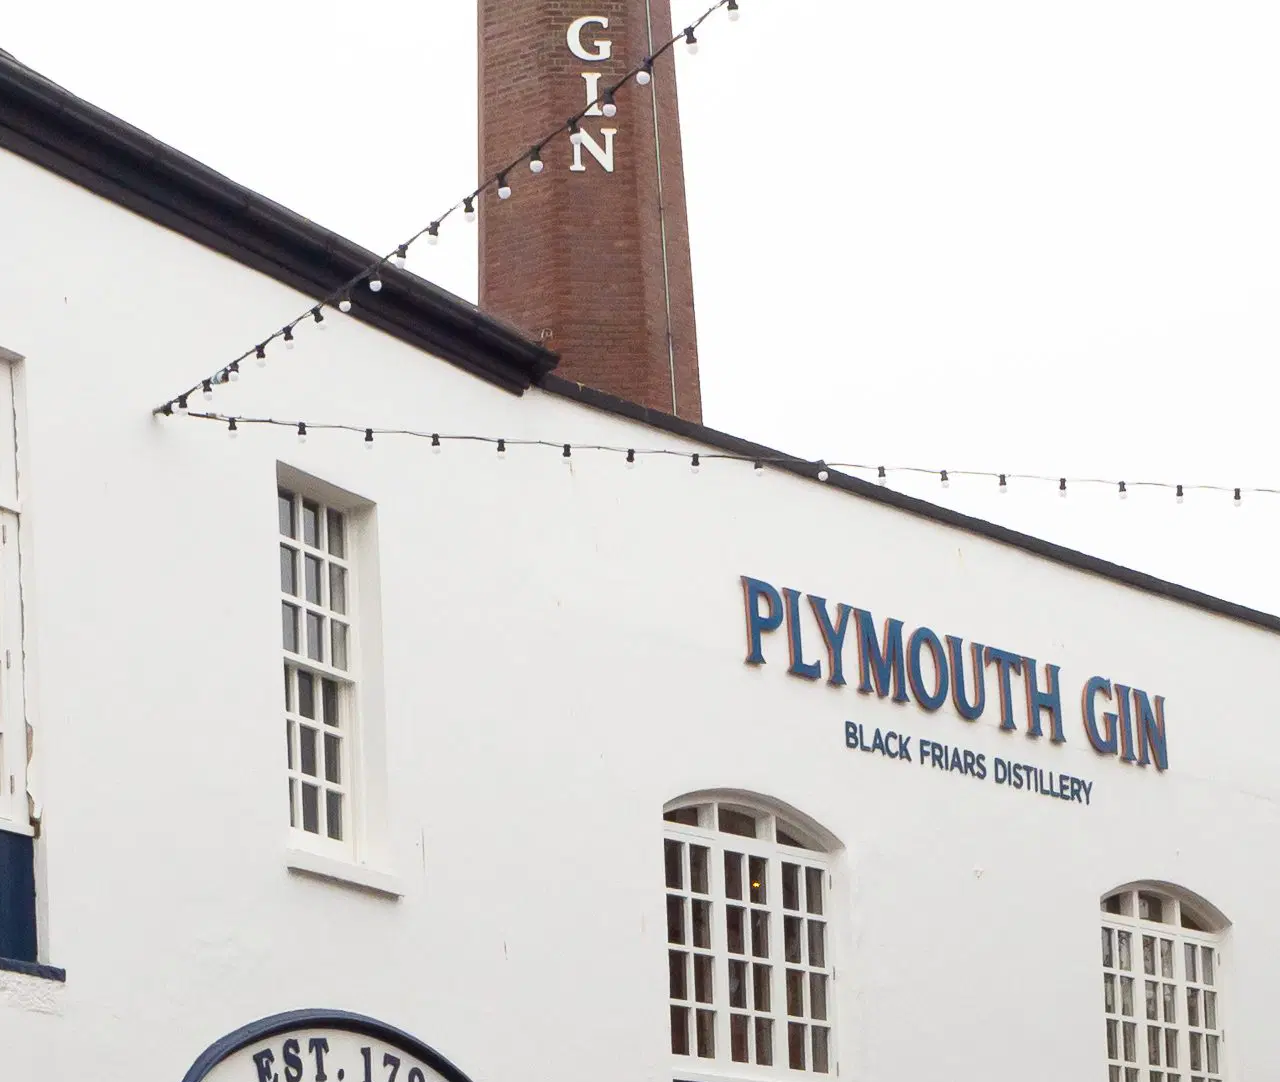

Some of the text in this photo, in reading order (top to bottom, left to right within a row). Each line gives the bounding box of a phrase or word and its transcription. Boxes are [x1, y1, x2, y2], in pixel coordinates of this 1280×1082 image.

[566, 15, 618, 173] GIN
[739, 575, 1170, 772] PLYMOUTH GIN
[844, 720, 1094, 806] BLACK FRIARS DISTILLERY
